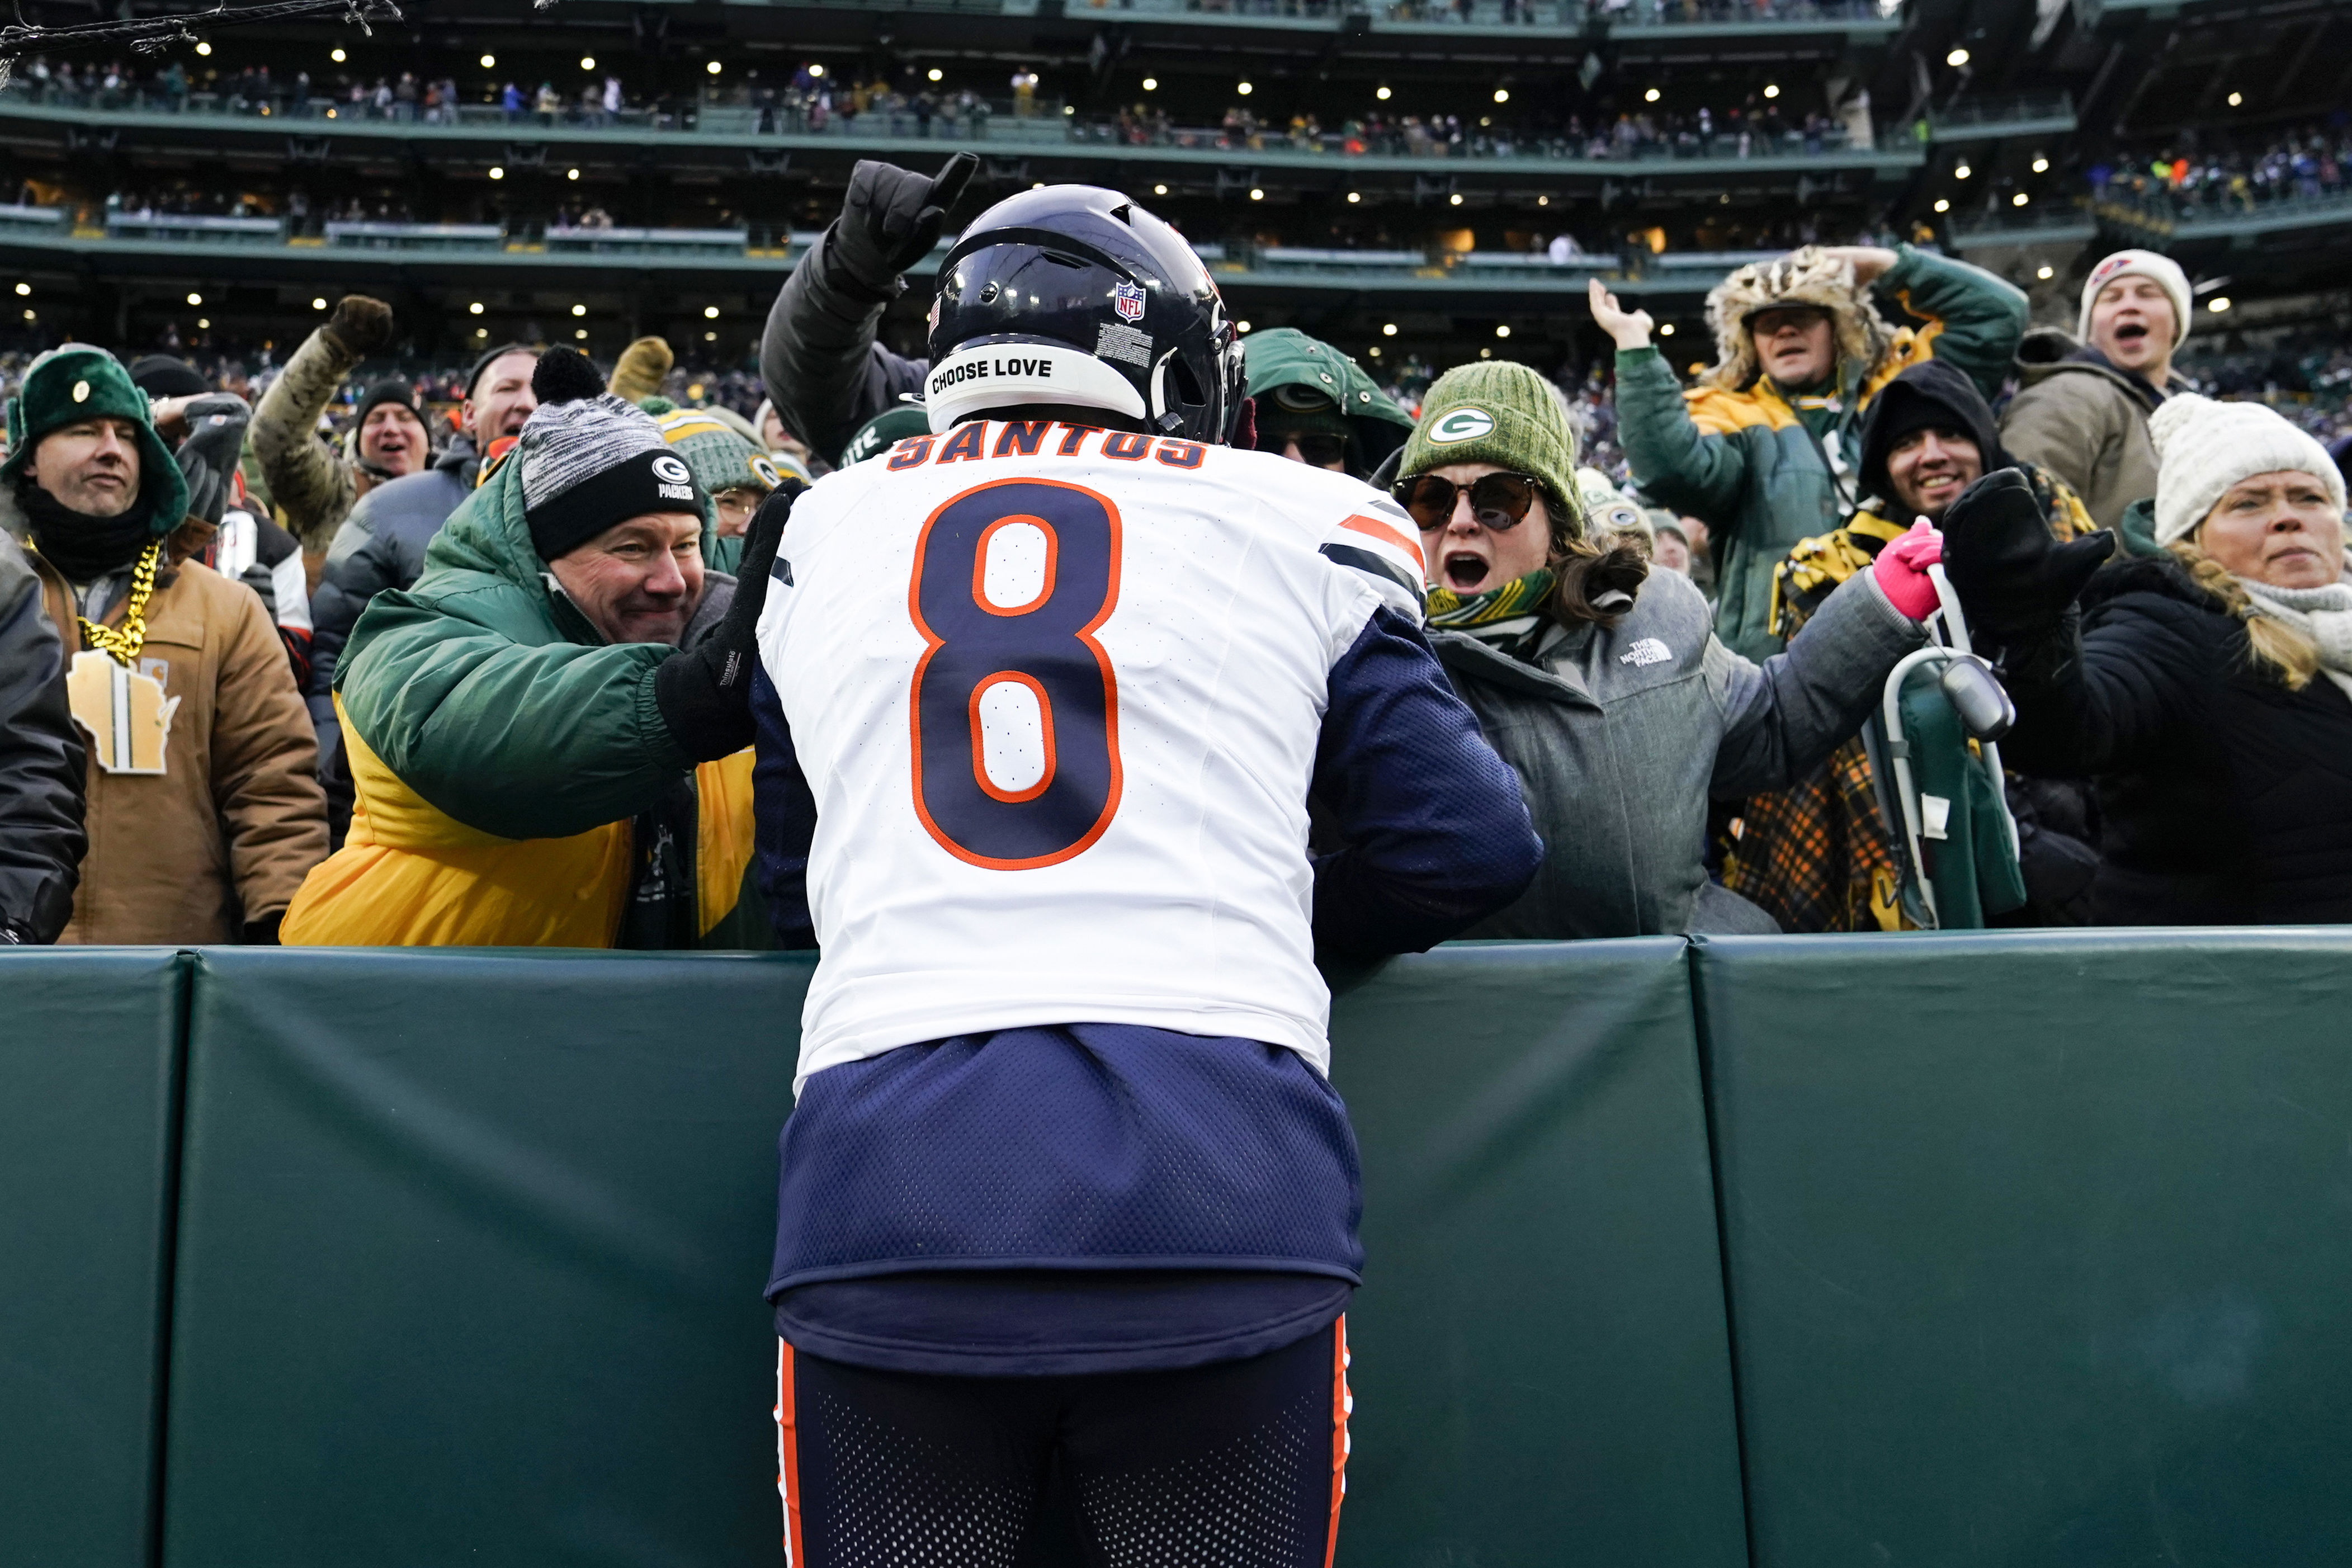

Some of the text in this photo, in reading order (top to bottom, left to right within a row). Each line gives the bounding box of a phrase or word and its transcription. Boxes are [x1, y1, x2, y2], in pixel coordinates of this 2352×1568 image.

[1120, 297, 1140, 315] NFL
[1114, 323, 1142, 333] WARNING
[932, 358, 1052, 394] CHOOSE LOVE
[1429, 408, 1494, 442] G
[886, 421, 1210, 471] SANTOS
[651, 456, 691, 485] G
[658, 483, 694, 500] PACKERS
[1629, 639, 1650, 650] THE
[1619, 648, 1654, 664] NORTH
[1635, 655, 1658, 667] FACE
[908, 476, 1123, 870] 8
